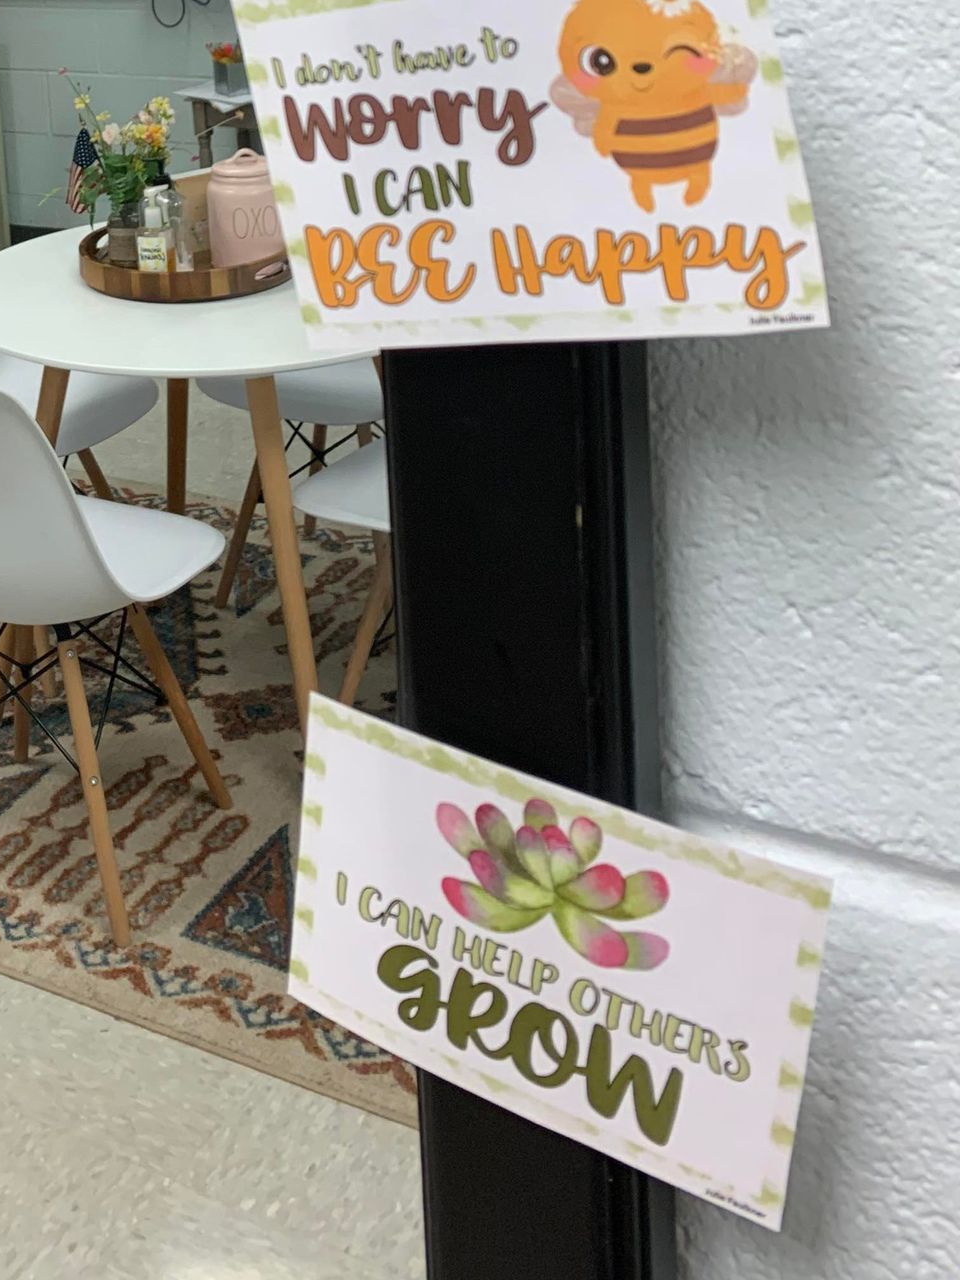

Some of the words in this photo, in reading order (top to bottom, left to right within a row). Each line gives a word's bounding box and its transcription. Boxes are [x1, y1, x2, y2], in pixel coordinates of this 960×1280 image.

[271, 56, 286, 88] I
[295, 44, 383, 86] don't
[393, 39, 476, 74] have
[479, 27, 519, 63] to
[341, 172, 360, 216] I
[374, 160, 473, 217] CAN
[490, 222, 806, 309] Happy
[336, 871, 348, 906] I
[358, 886, 443, 950] CAN
[452, 926, 559, 995] HELP
[569, 978, 751, 1082] OTHERS
